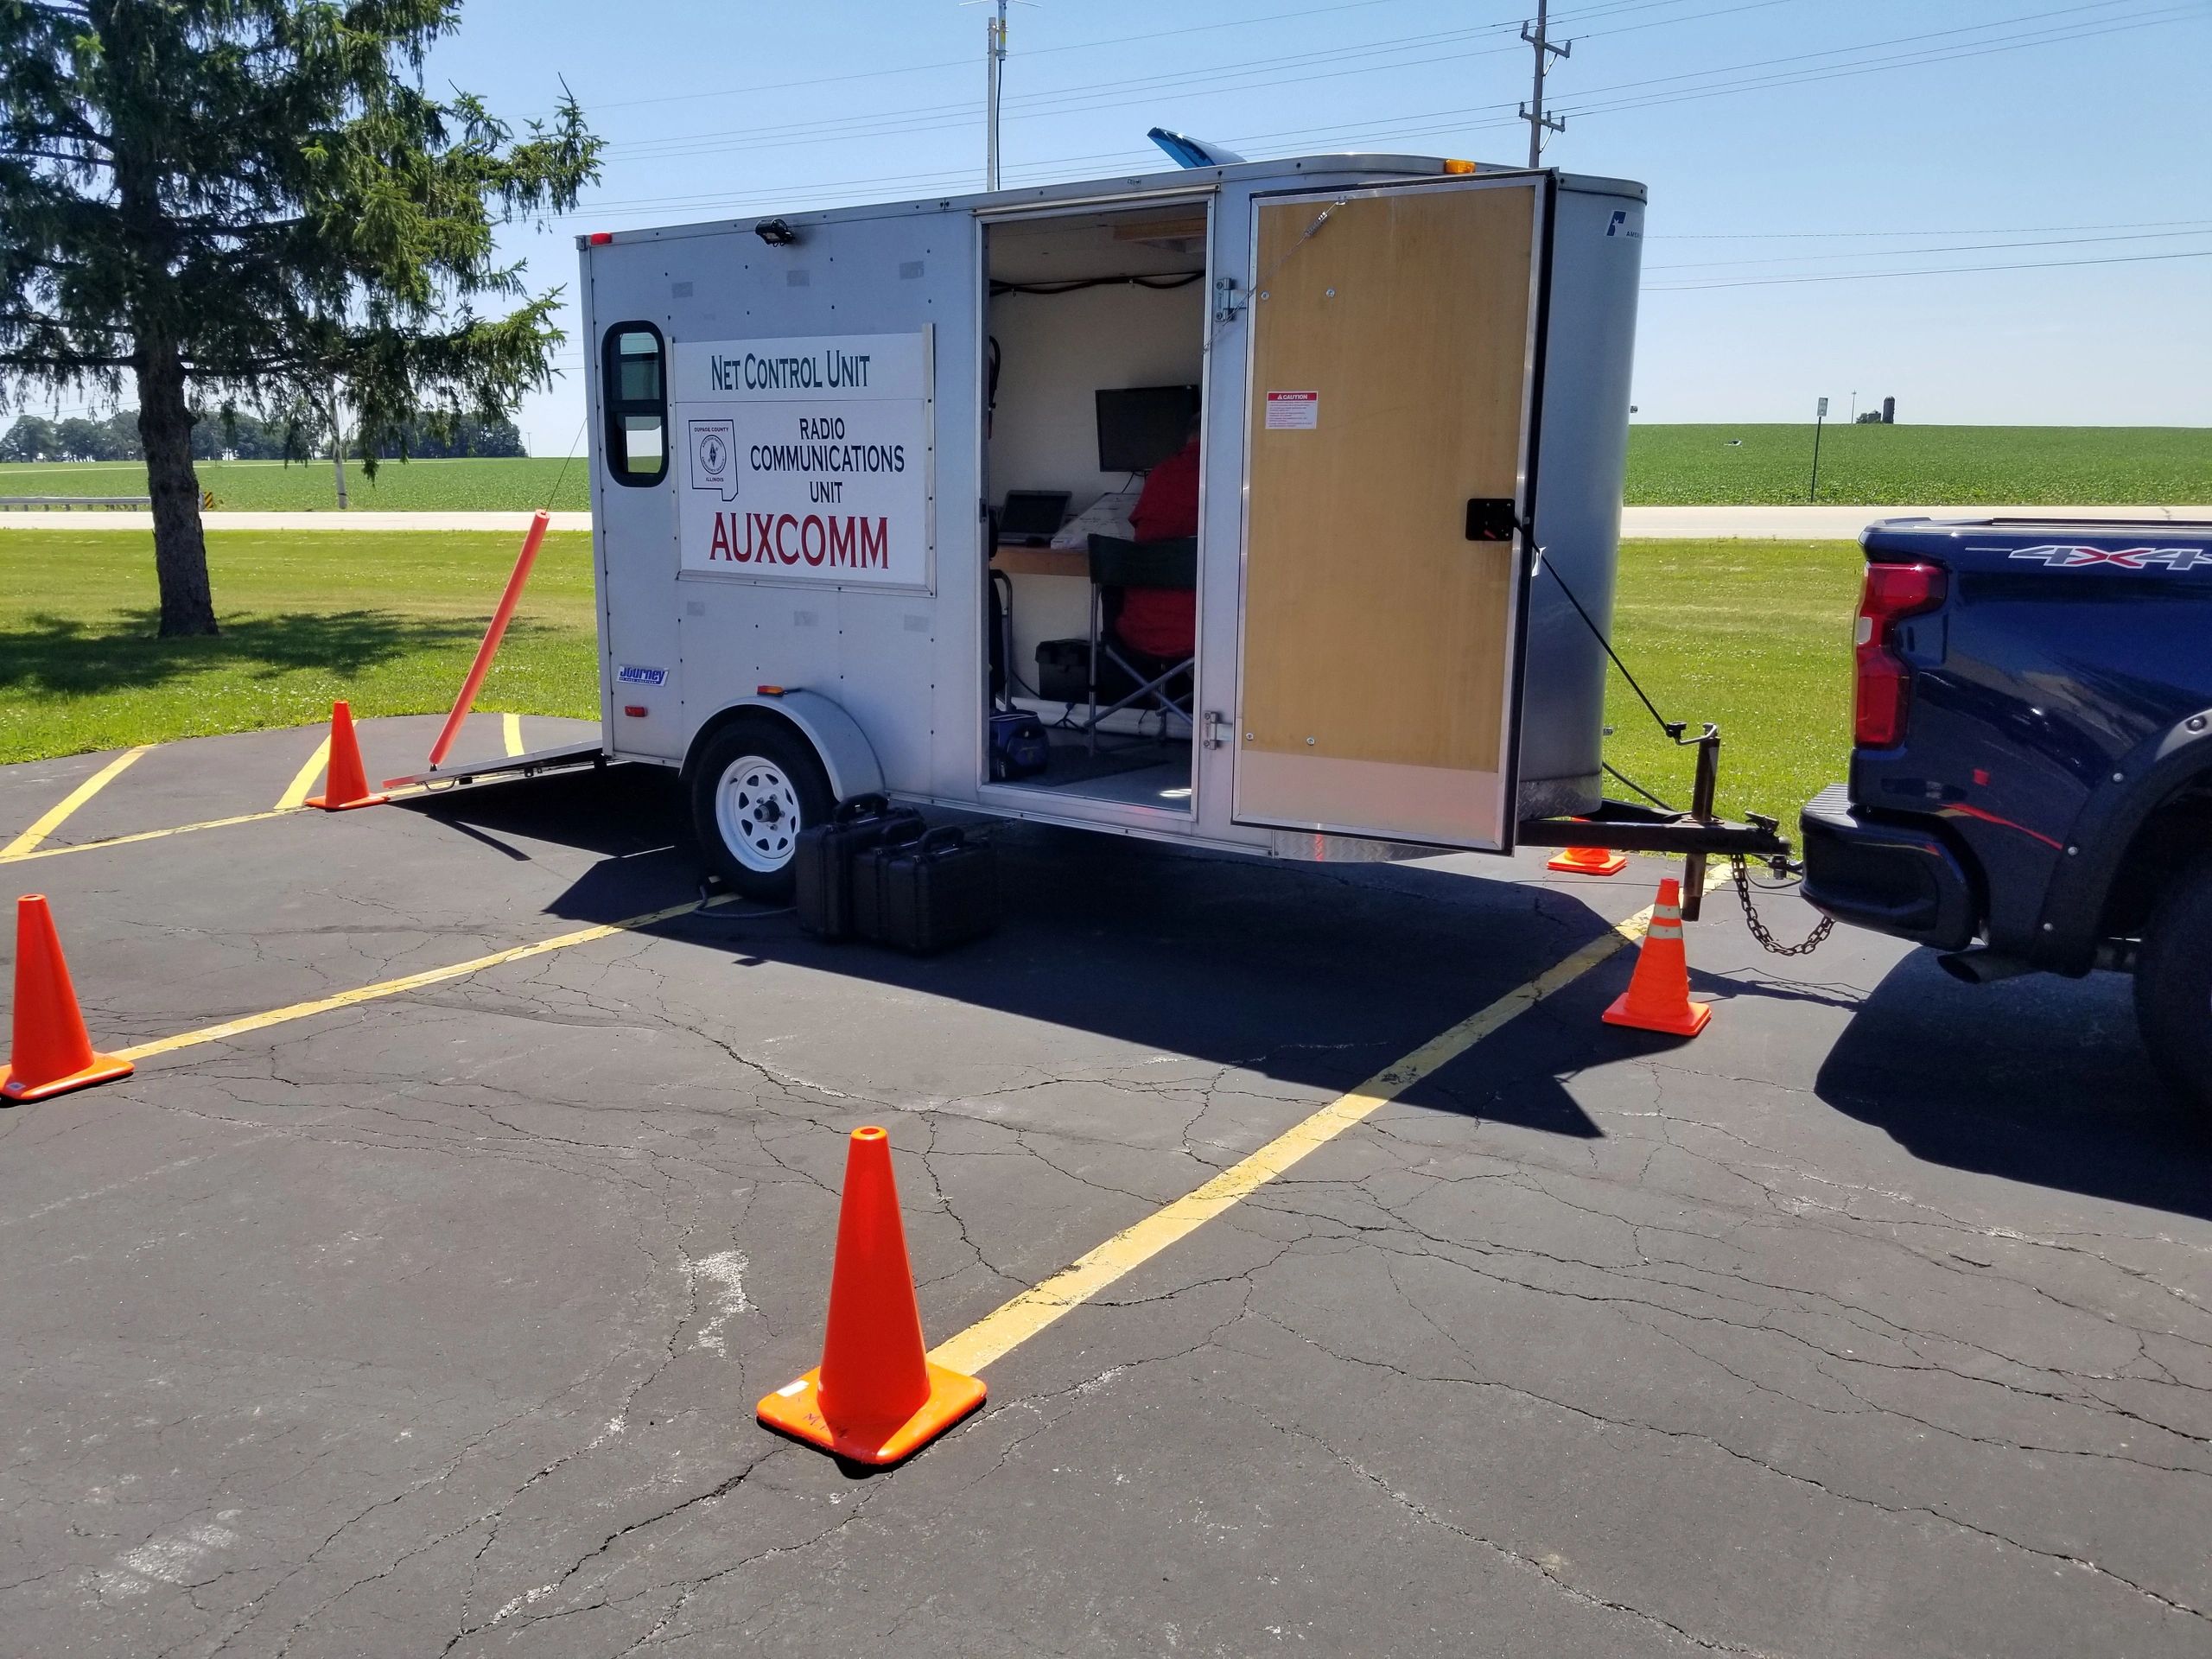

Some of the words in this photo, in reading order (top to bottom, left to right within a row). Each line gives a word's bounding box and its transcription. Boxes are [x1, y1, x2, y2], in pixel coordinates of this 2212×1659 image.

[711, 355, 741, 391] NET
[744, 353, 823, 390] CONTROL
[827, 350, 870, 388] UNIT
[799, 417, 845, 440] RADIO
[750, 445, 905, 473] COMMUNICATIONS
[810, 481, 842, 503] UNIT
[709, 512, 889, 569] AUXCOMM
[620, 667, 665, 684] Journey
